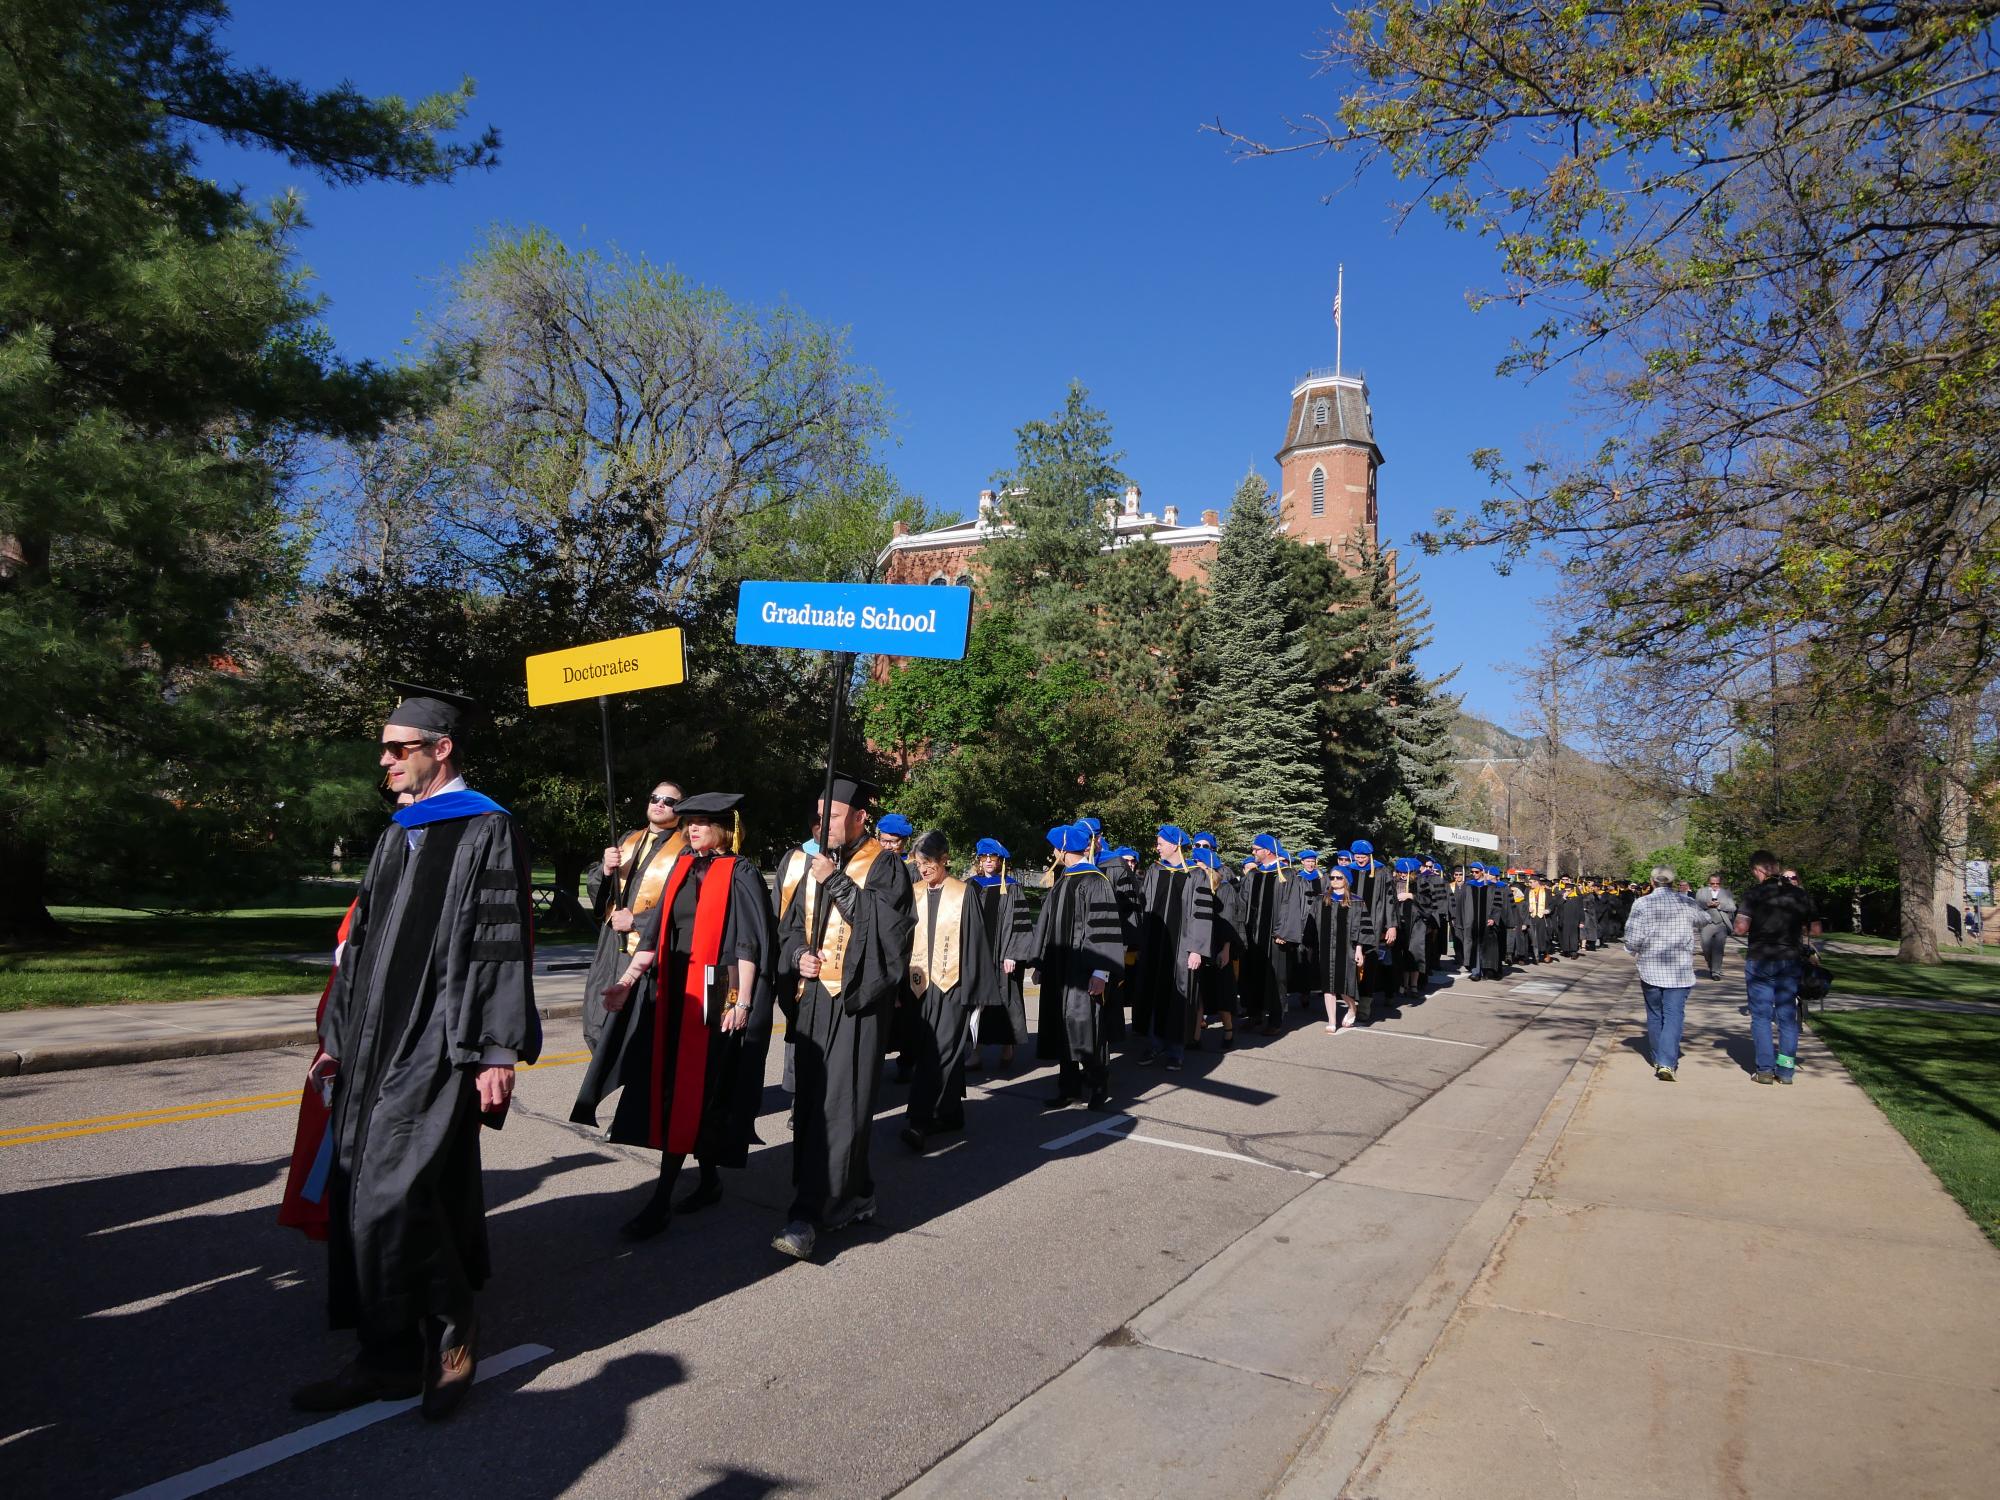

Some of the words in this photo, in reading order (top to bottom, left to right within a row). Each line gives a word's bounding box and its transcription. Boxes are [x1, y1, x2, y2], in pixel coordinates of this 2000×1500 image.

[762, 601, 855, 629] Graduate
[861, 605, 936, 633] School
[563, 656, 639, 684] Doctorates
[1451, 832, 1481, 843] Masters
